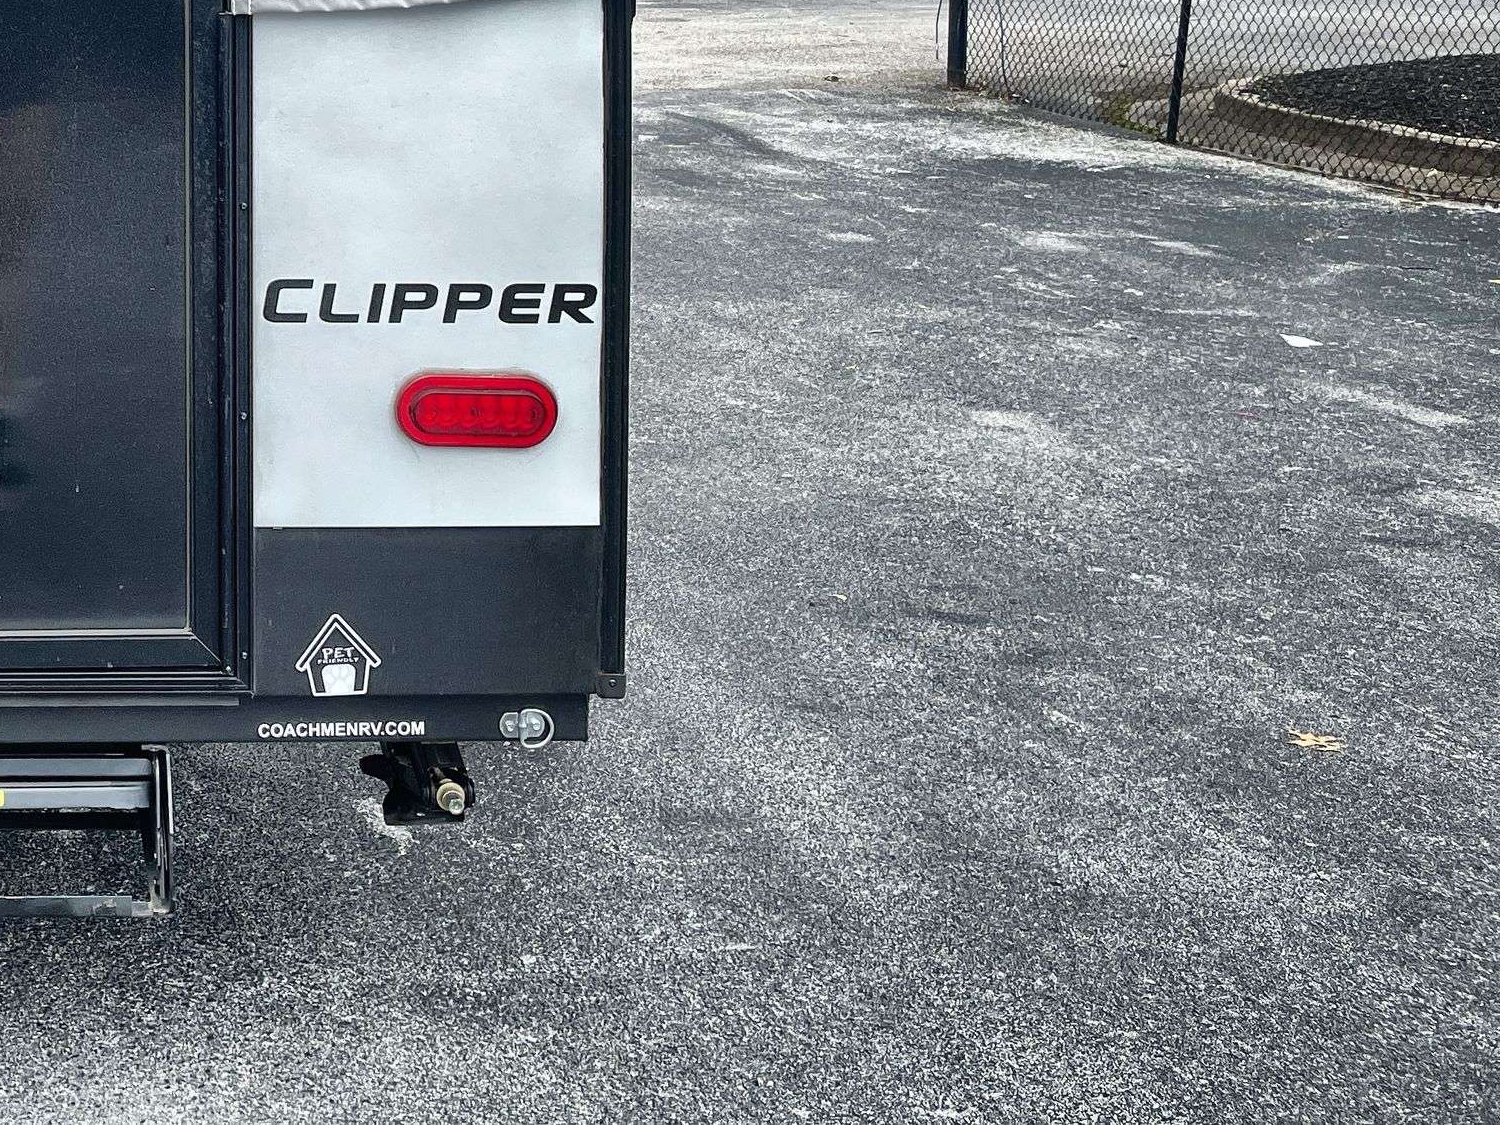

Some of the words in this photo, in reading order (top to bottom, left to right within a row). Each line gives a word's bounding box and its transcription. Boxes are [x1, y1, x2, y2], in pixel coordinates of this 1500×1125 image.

[262, 278, 599, 324] CLIPPER
[317, 657, 359, 665] FRIENDLY
[321, 647, 355, 660] PET
[257, 721, 425, 738] COACHMENRV.COM
